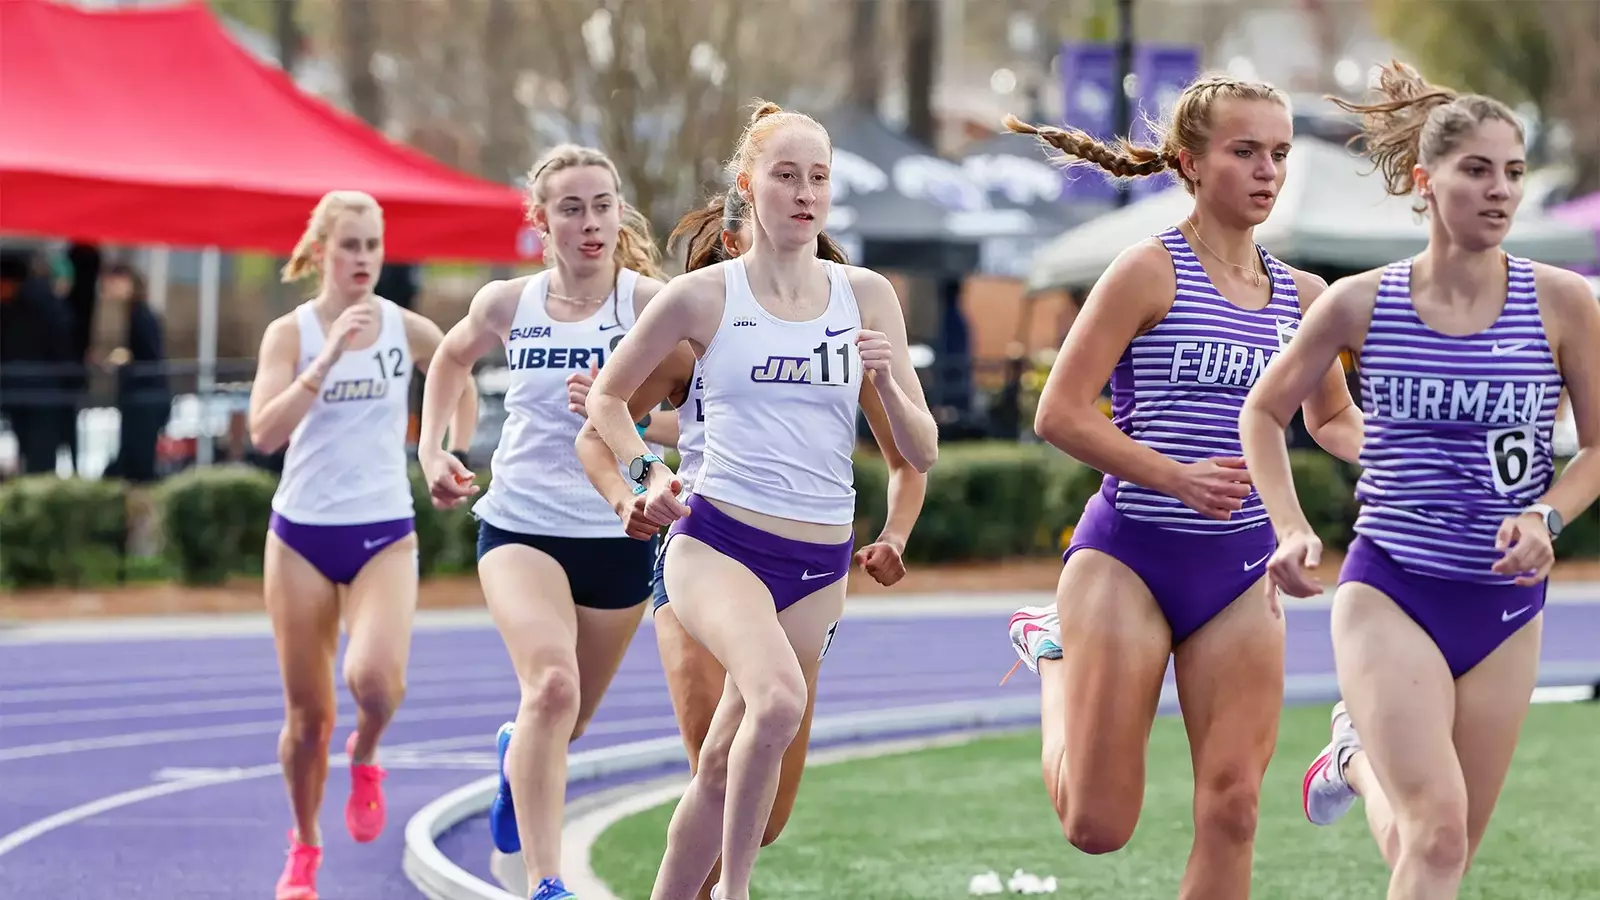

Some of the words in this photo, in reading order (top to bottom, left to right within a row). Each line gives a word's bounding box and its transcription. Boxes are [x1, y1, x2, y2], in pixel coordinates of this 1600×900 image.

[373, 348, 404, 379] 12
[509, 348, 605, 370] LIBERT
[751, 356, 811, 384] JM
[813, 342, 850, 384] 11
[1169, 341, 1281, 388] FURM
[1368, 375, 1547, 425] FURMAN
[1493, 430, 1529, 487] 6
